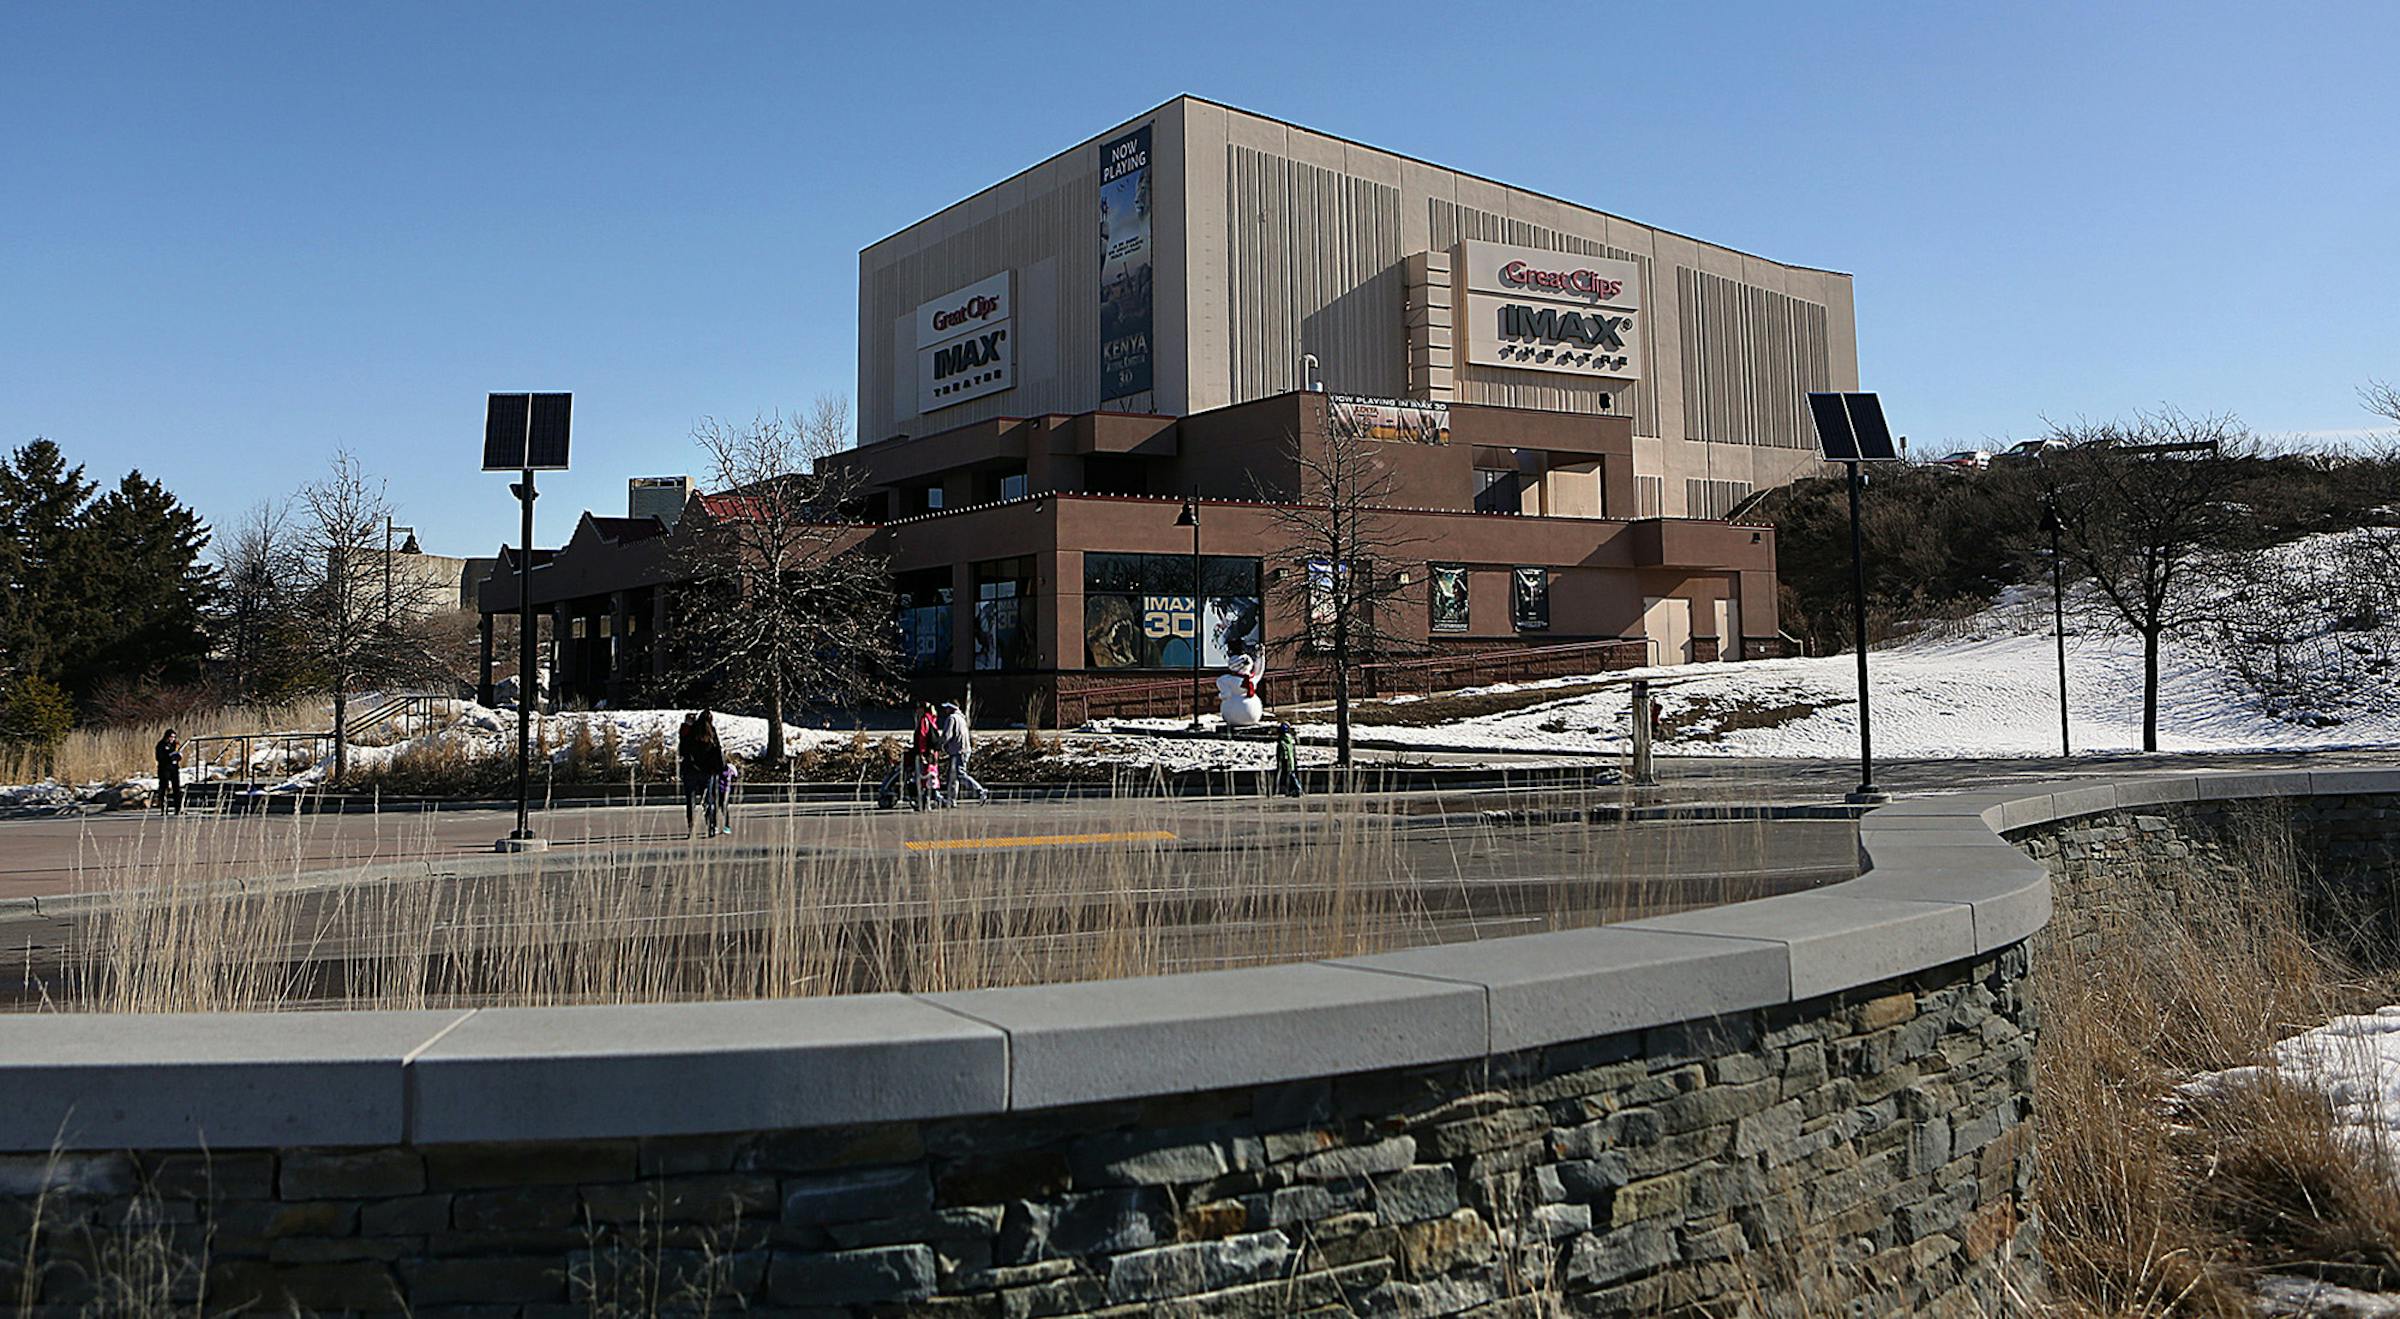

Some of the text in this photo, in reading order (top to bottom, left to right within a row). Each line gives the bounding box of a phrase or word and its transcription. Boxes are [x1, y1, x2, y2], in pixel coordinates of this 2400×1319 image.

[1111, 138, 1138, 163] NOW
[1103, 150, 1146, 183] PLAYING
[1504, 260, 1622, 300] Great Clips
[933, 295, 998, 331] Great Clips
[1502, 304, 1625, 349] IMAX
[934, 331, 1001, 380] IMAX
[1103, 334, 1148, 361] KENYA
[1500, 345, 1628, 370] THEATRE
[933, 369, 1002, 397] THEATRE
[1356, 396, 1396, 406] PLAYING
[1144, 596, 1195, 611] IMAX
[1144, 611, 1197, 639] 3D
